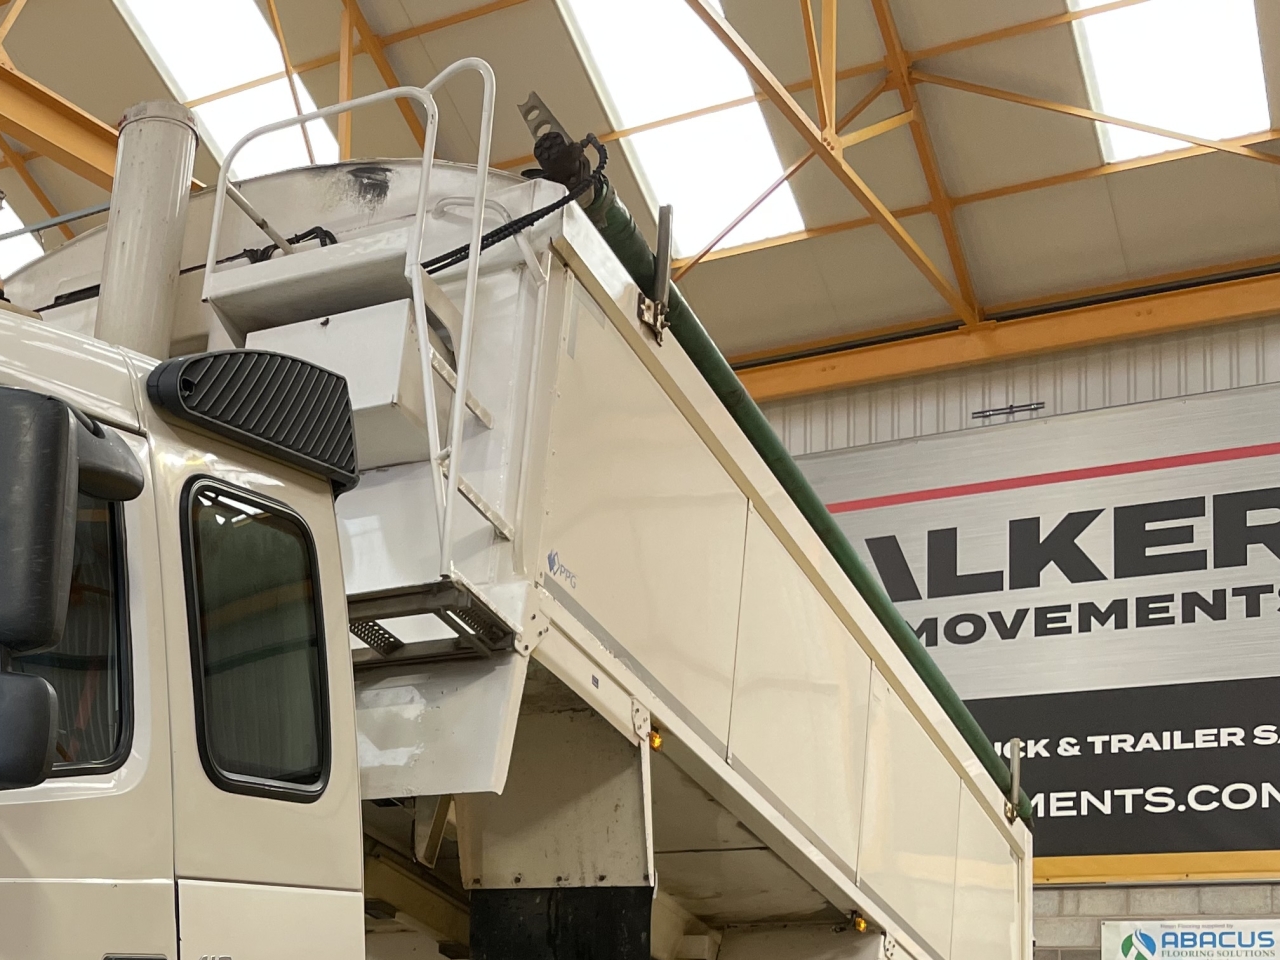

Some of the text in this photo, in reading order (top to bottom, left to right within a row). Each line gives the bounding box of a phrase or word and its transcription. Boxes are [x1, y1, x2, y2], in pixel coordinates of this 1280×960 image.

[560, 563, 577, 590] PPG
[906, 583, 1280, 648] MOVEMENT
[1056, 736, 1082, 757] &
[1086, 726, 1246, 755] TRAILER
[1252, 724, 1280, 746] S
[1161, 930, 1276, 949] ABACUS
[1161, 949, 1276, 958] FLOORING SOLUTIONS
